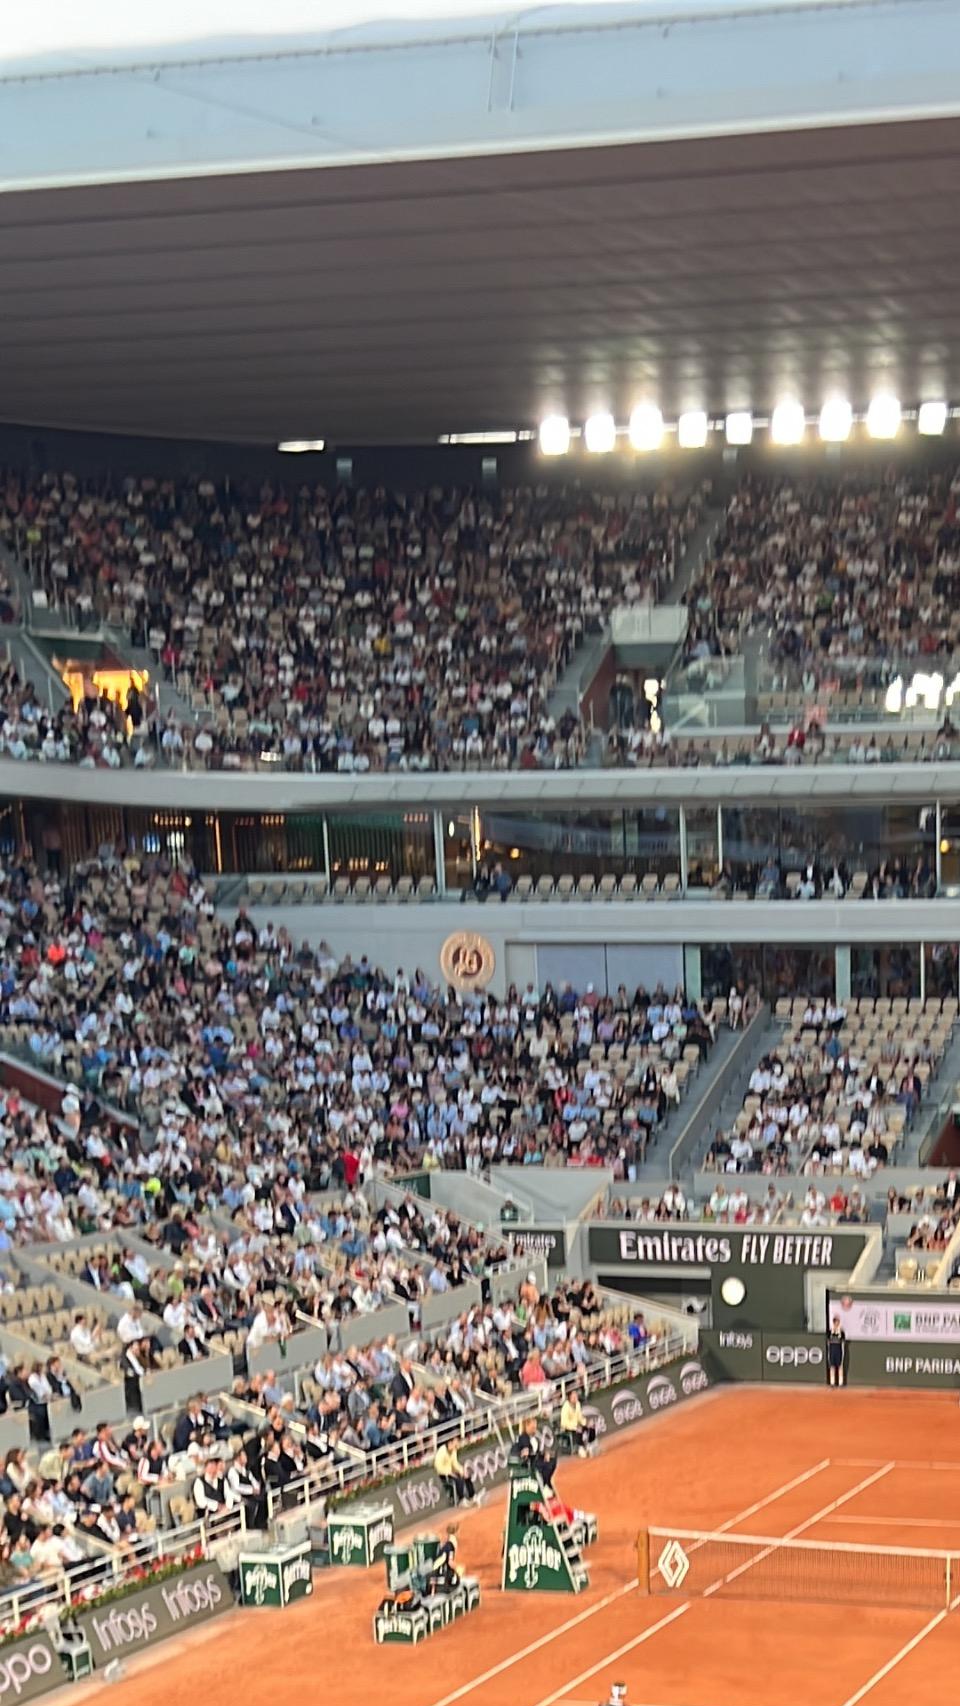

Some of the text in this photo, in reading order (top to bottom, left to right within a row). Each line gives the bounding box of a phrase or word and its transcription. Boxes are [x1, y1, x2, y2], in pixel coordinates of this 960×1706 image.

[619, 1231, 833, 1266] Emirates FLY BETTER
[765, 1345, 823, 1367] oppo
[885, 1356, 913, 1374] BNP
[162, 1573, 222, 1622] Infosys
[92, 1602, 157, 1652] Infosys
